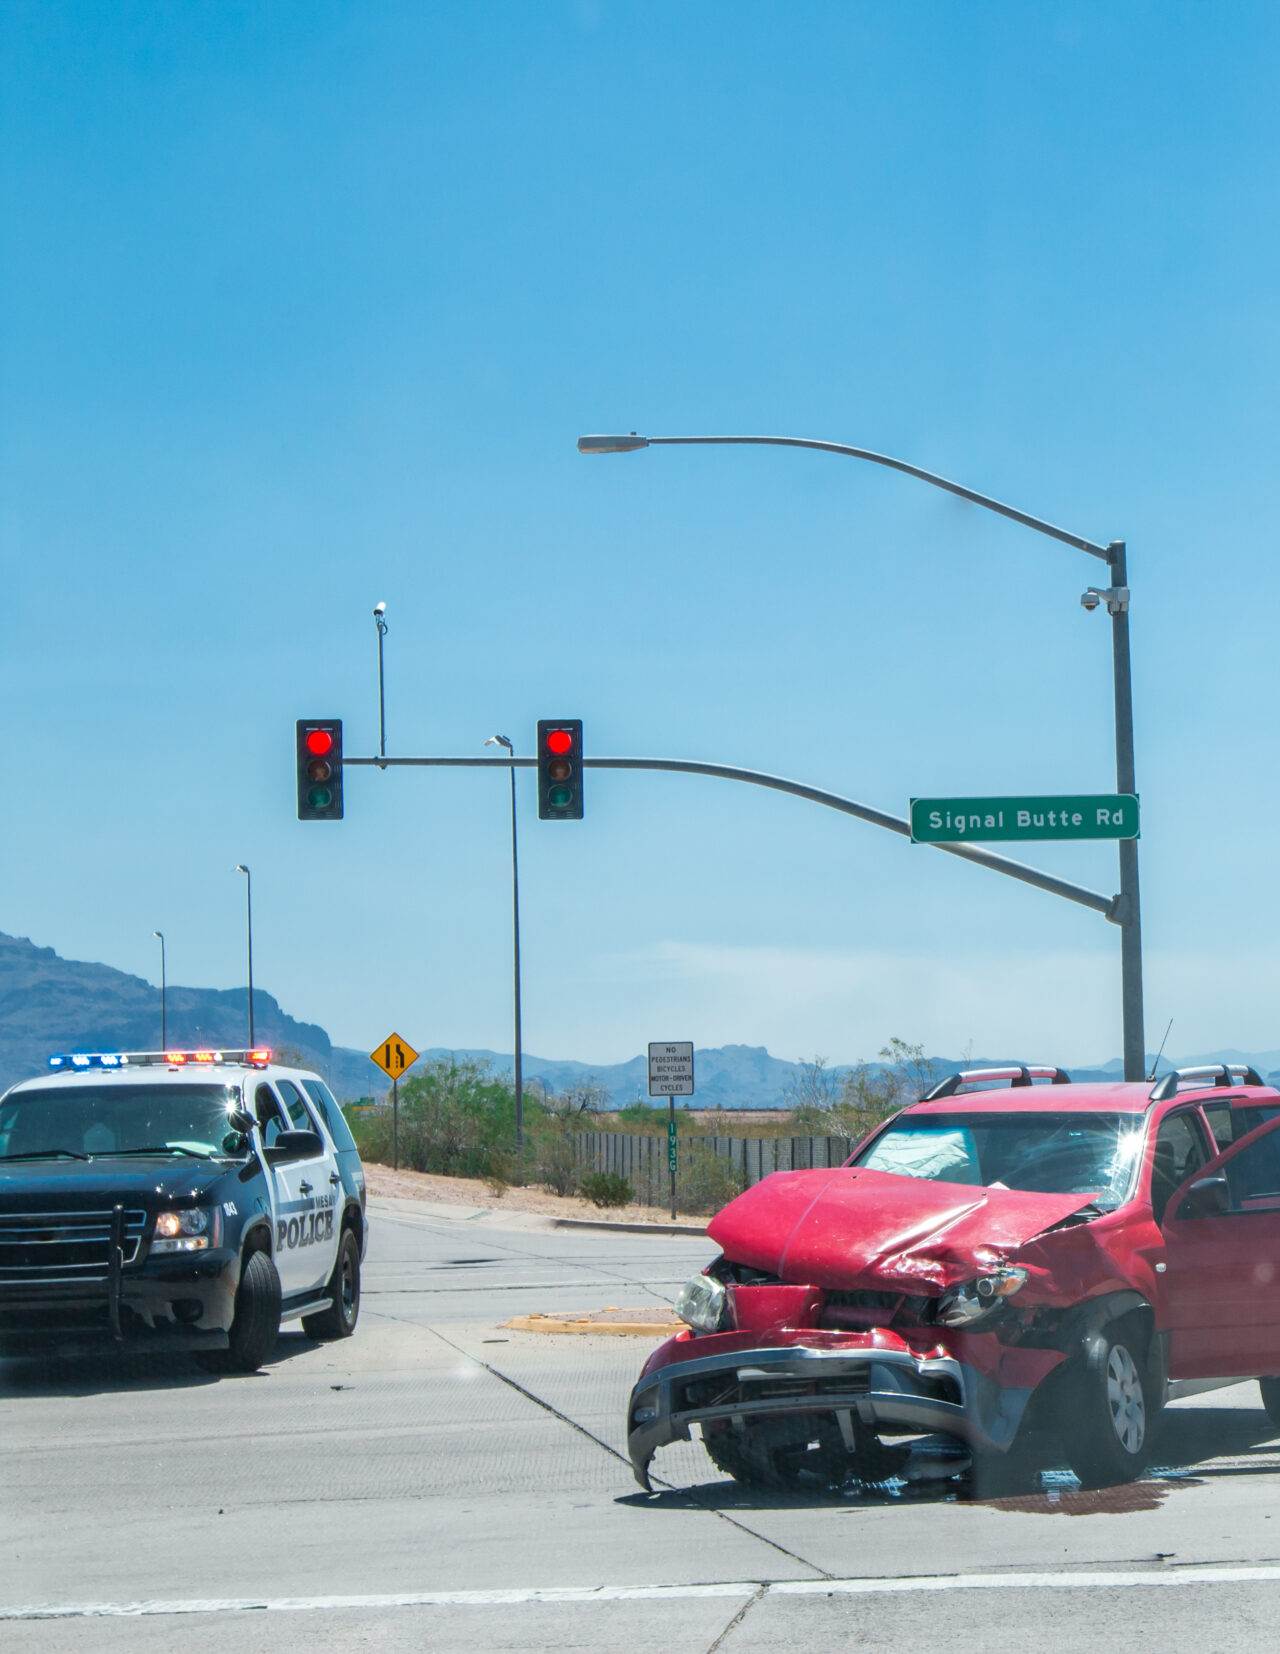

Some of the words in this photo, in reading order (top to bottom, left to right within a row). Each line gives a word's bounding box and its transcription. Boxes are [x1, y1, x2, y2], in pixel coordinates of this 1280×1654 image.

[929, 811, 1003, 833] Signal
[1017, 810, 1083, 827] Butte
[1096, 808, 1123, 825] Rd
[660, 1084, 683, 1092] CYCLES
[276, 1209, 334, 1252] POLICE
